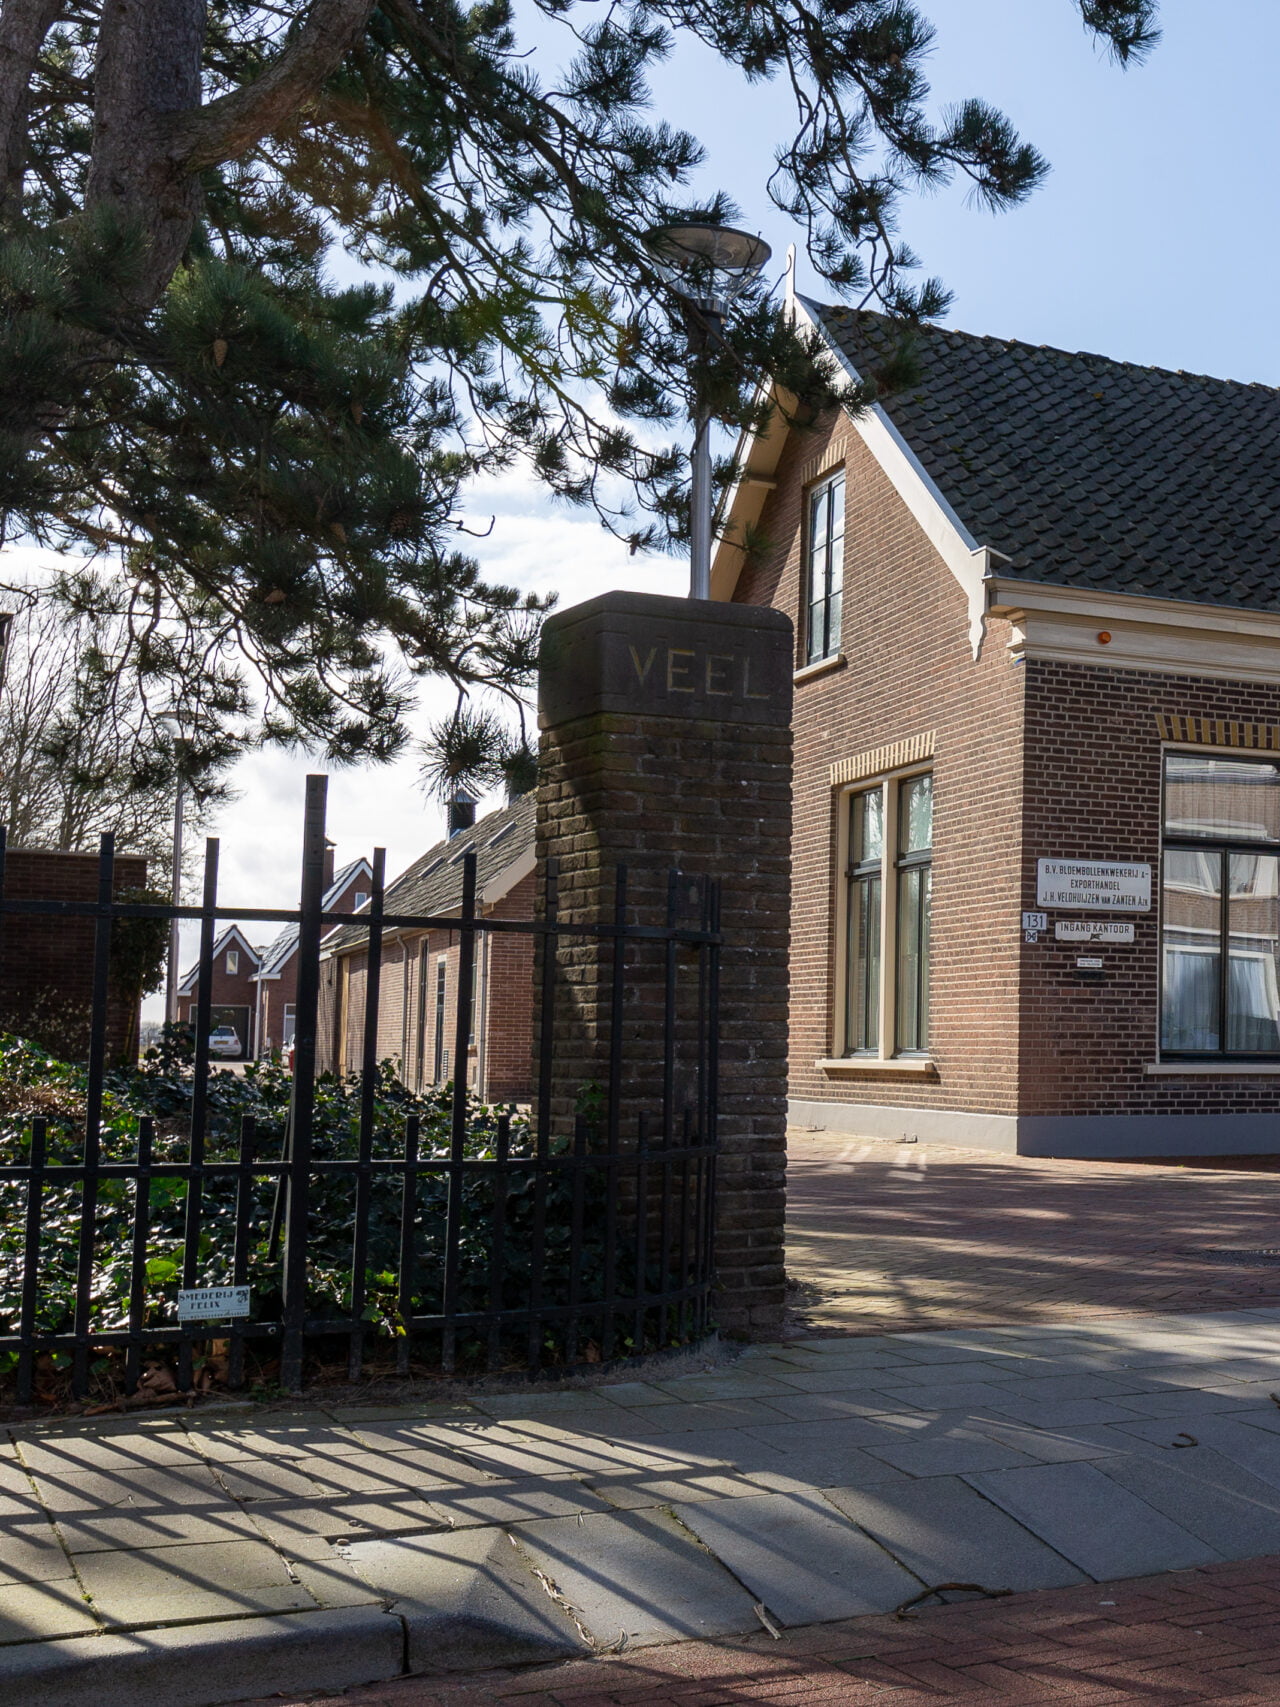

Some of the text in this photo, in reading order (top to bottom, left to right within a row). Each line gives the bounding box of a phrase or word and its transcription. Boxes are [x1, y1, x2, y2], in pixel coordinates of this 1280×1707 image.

[628, 644, 770, 700] VEEL
[1045, 864, 1058, 874] B.V.
[1059, 865, 1139, 879] BLOEMBOLLENKWEKERIJ
[1070, 879, 1121, 890] EXPORTHANDEL
[1043, 891, 1056, 902] J.H.
[1057, 892, 1100, 904] VELDHUIJZEN
[1112, 894, 1136, 906] ZANTEN
[1027, 914, 1043, 928] 131
[1060, 923, 1130, 934] INGANG KANTOOR
[179, 1291, 233, 1301] SMEDERIJ
[191, 1301, 220, 1309] FELIX
